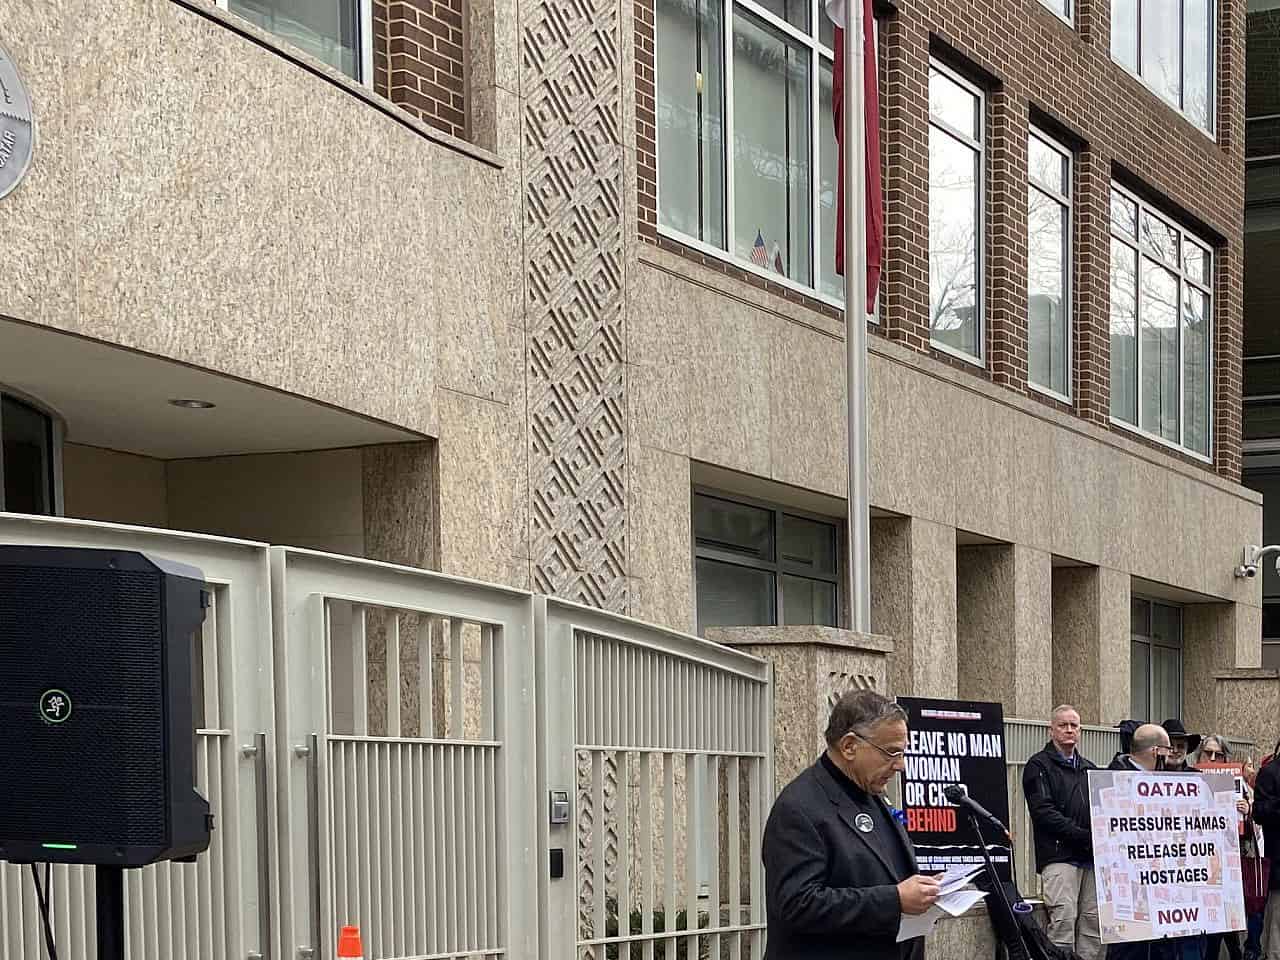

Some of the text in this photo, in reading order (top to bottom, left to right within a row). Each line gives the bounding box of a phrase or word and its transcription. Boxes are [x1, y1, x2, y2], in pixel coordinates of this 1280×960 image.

[947, 732, 967, 756] NO
[969, 733, 1002, 758] MAN
[903, 756, 961, 782] WOMAN
[905, 781, 926, 807] OR
[906, 808, 957, 832] BEHIND
[1110, 816, 1226, 832] PRESSURE HAMAS
[1127, 843, 1215, 859] RELEASE OUR
[1140, 868, 1208, 885] HOSTAGES
[1157, 907, 1199, 925] NOW
